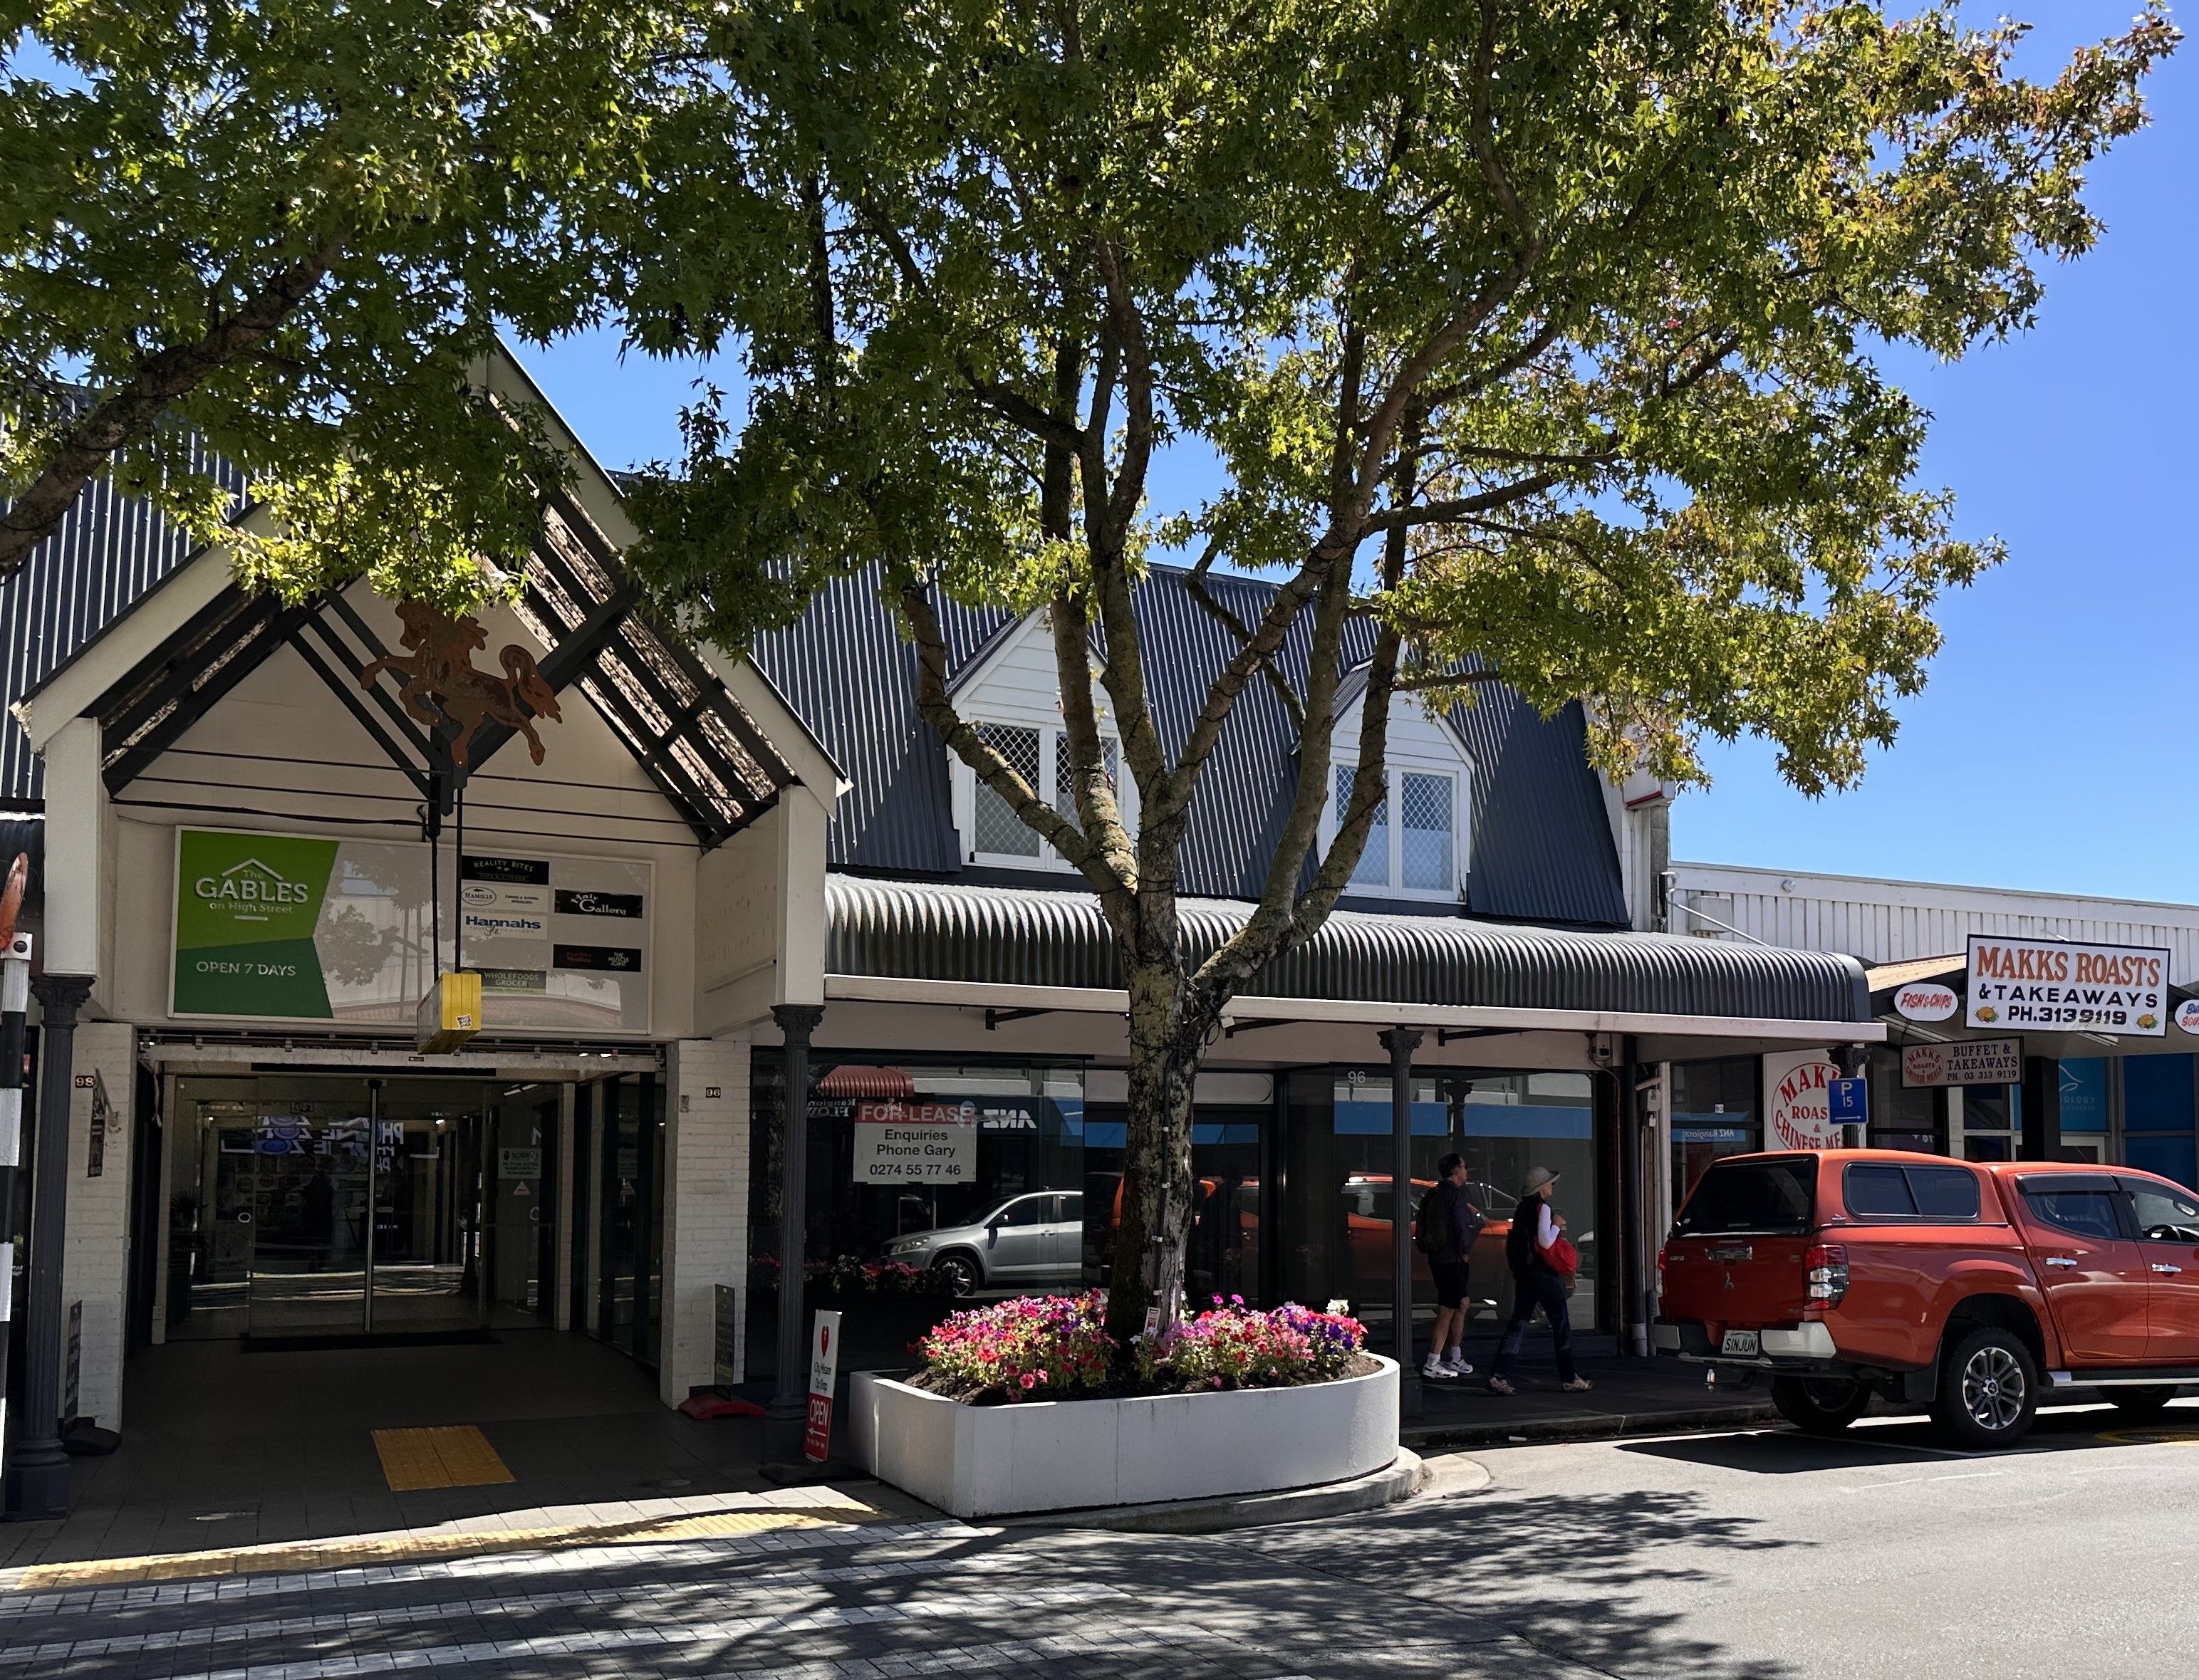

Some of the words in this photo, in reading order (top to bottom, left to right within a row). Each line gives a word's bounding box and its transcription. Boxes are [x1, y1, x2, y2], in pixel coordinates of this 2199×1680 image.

[511, 862, 534, 872] BITES
[243, 870, 264, 879] The
[195, 877, 308, 903] GABLES
[229, 902, 256, 912] High
[259, 904, 293, 914] Street
[578, 899, 627, 916] Gallery
[465, 916, 541, 929] Hannahs
[197, 961, 241, 974] OPEN
[244, 964, 254, 974] 7
[258, 964, 296, 976] DAYS
[1976, 946, 2069, 981] MAKKS
[2075, 952, 2161, 988] ROASTS
[484, 972, 539, 981] WHOLEFOODS
[1953, 1044, 1998, 1057] BUFFET
[2003, 1043, 2012, 1054] &
[1947, 1056, 2017, 1070] TAKEAWAYS
[76, 1077, 94, 1087] 98
[1348, 1070, 1366, 1083] 96
[1841, 1082, 1853, 1096] P
[1842, 1095, 1854, 1107] 15
[861, 1105, 903, 1121] FOR
[909, 1106, 974, 1122] LEASE
[1814, 1123, 1821, 1133] &
[885, 1129, 948, 1142] Enquiries
[876, 1144, 920, 1156] Phone
[924, 1144, 956, 1158] Gary
[870, 1164, 902, 1175] 0274
[906, 1164, 922, 1175] 55
[926, 1164, 942, 1175] 77
[945, 1164, 961, 1175] 46
[1725, 1338, 1757, 1352] SINJUN
[809, 1399, 829, 1427] OPEN
